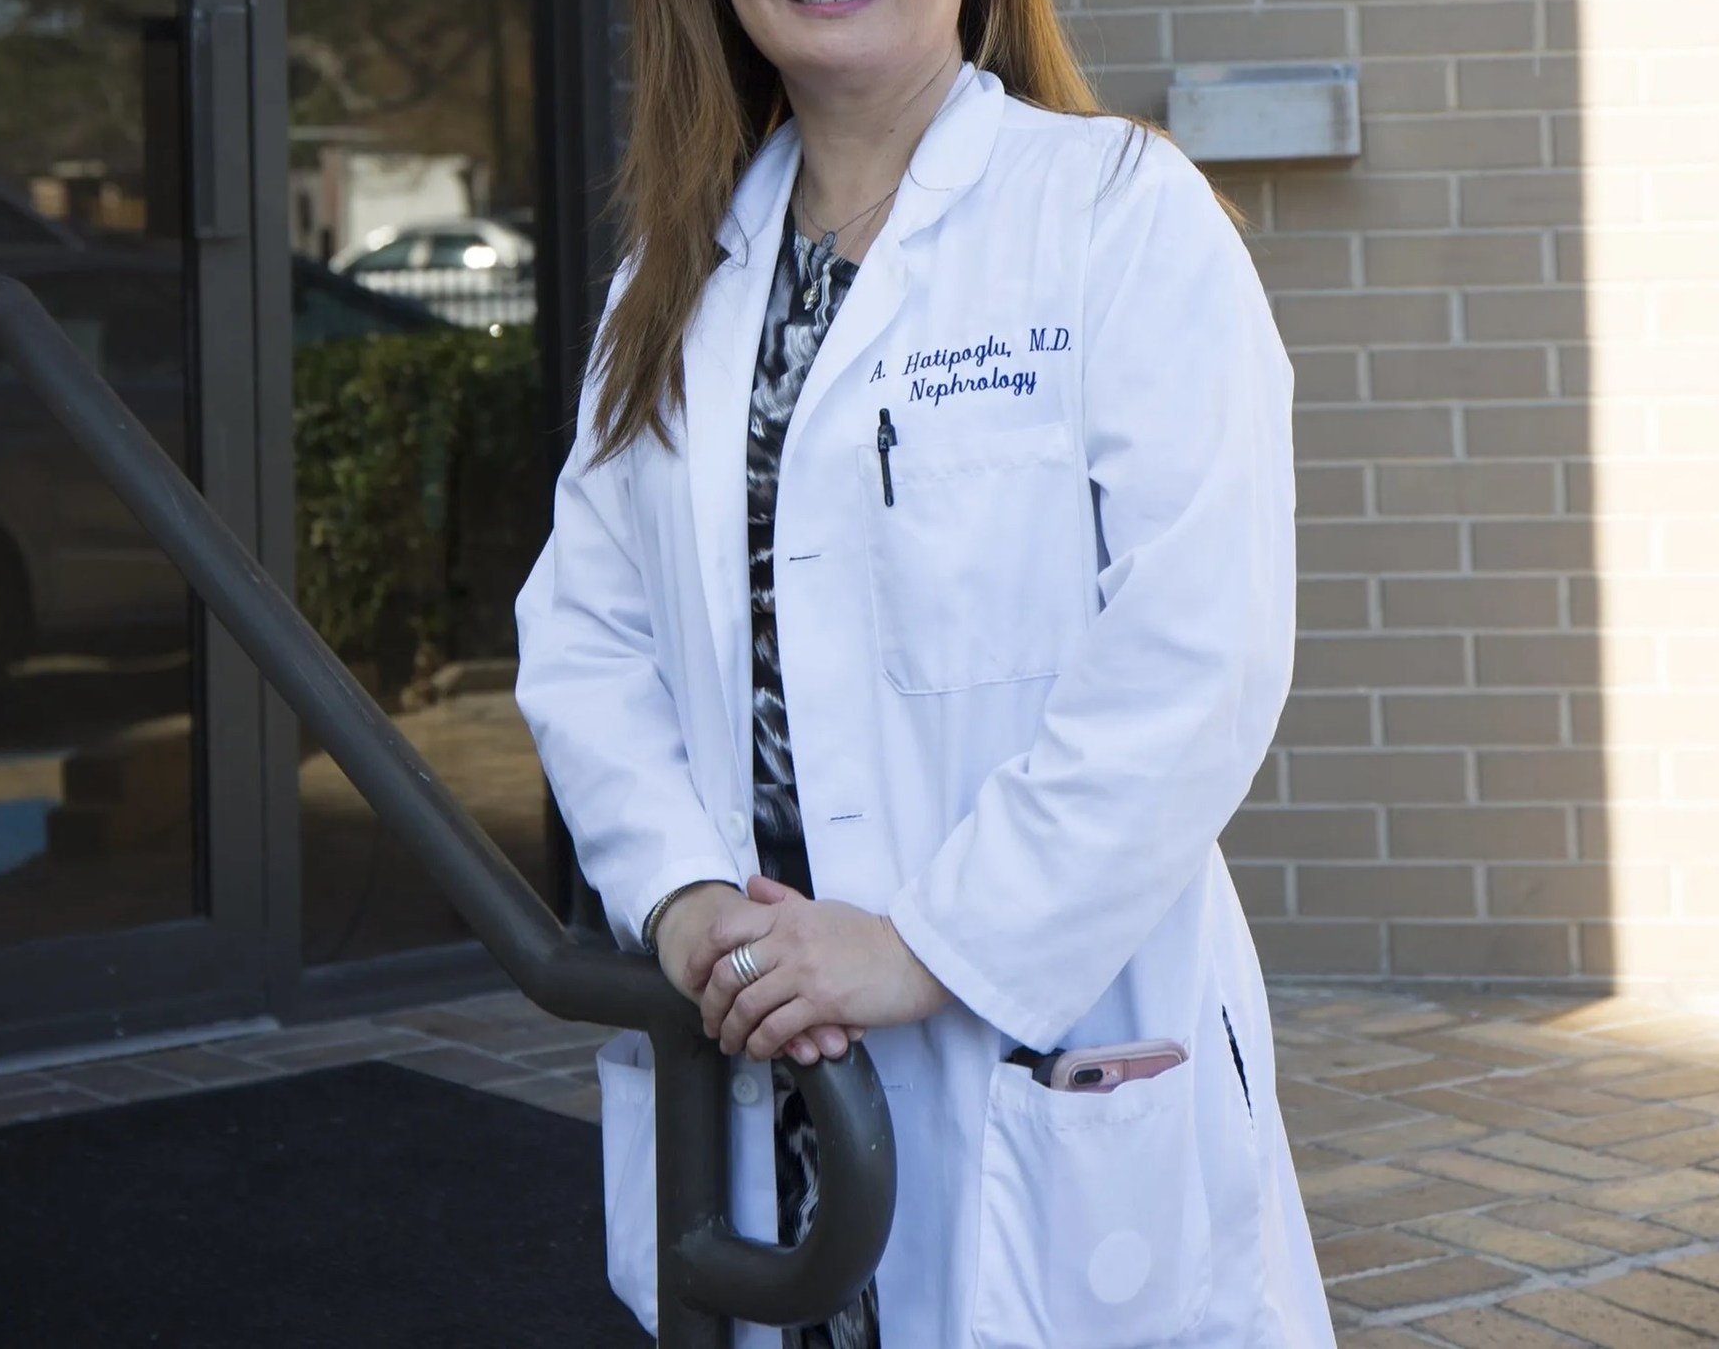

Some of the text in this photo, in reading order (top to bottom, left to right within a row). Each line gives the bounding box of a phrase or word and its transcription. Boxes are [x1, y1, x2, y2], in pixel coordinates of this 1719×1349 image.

[869, 327, 1072, 384] A. Hatipoglu, M.D.
[908, 366, 1037, 407] Nephrology
